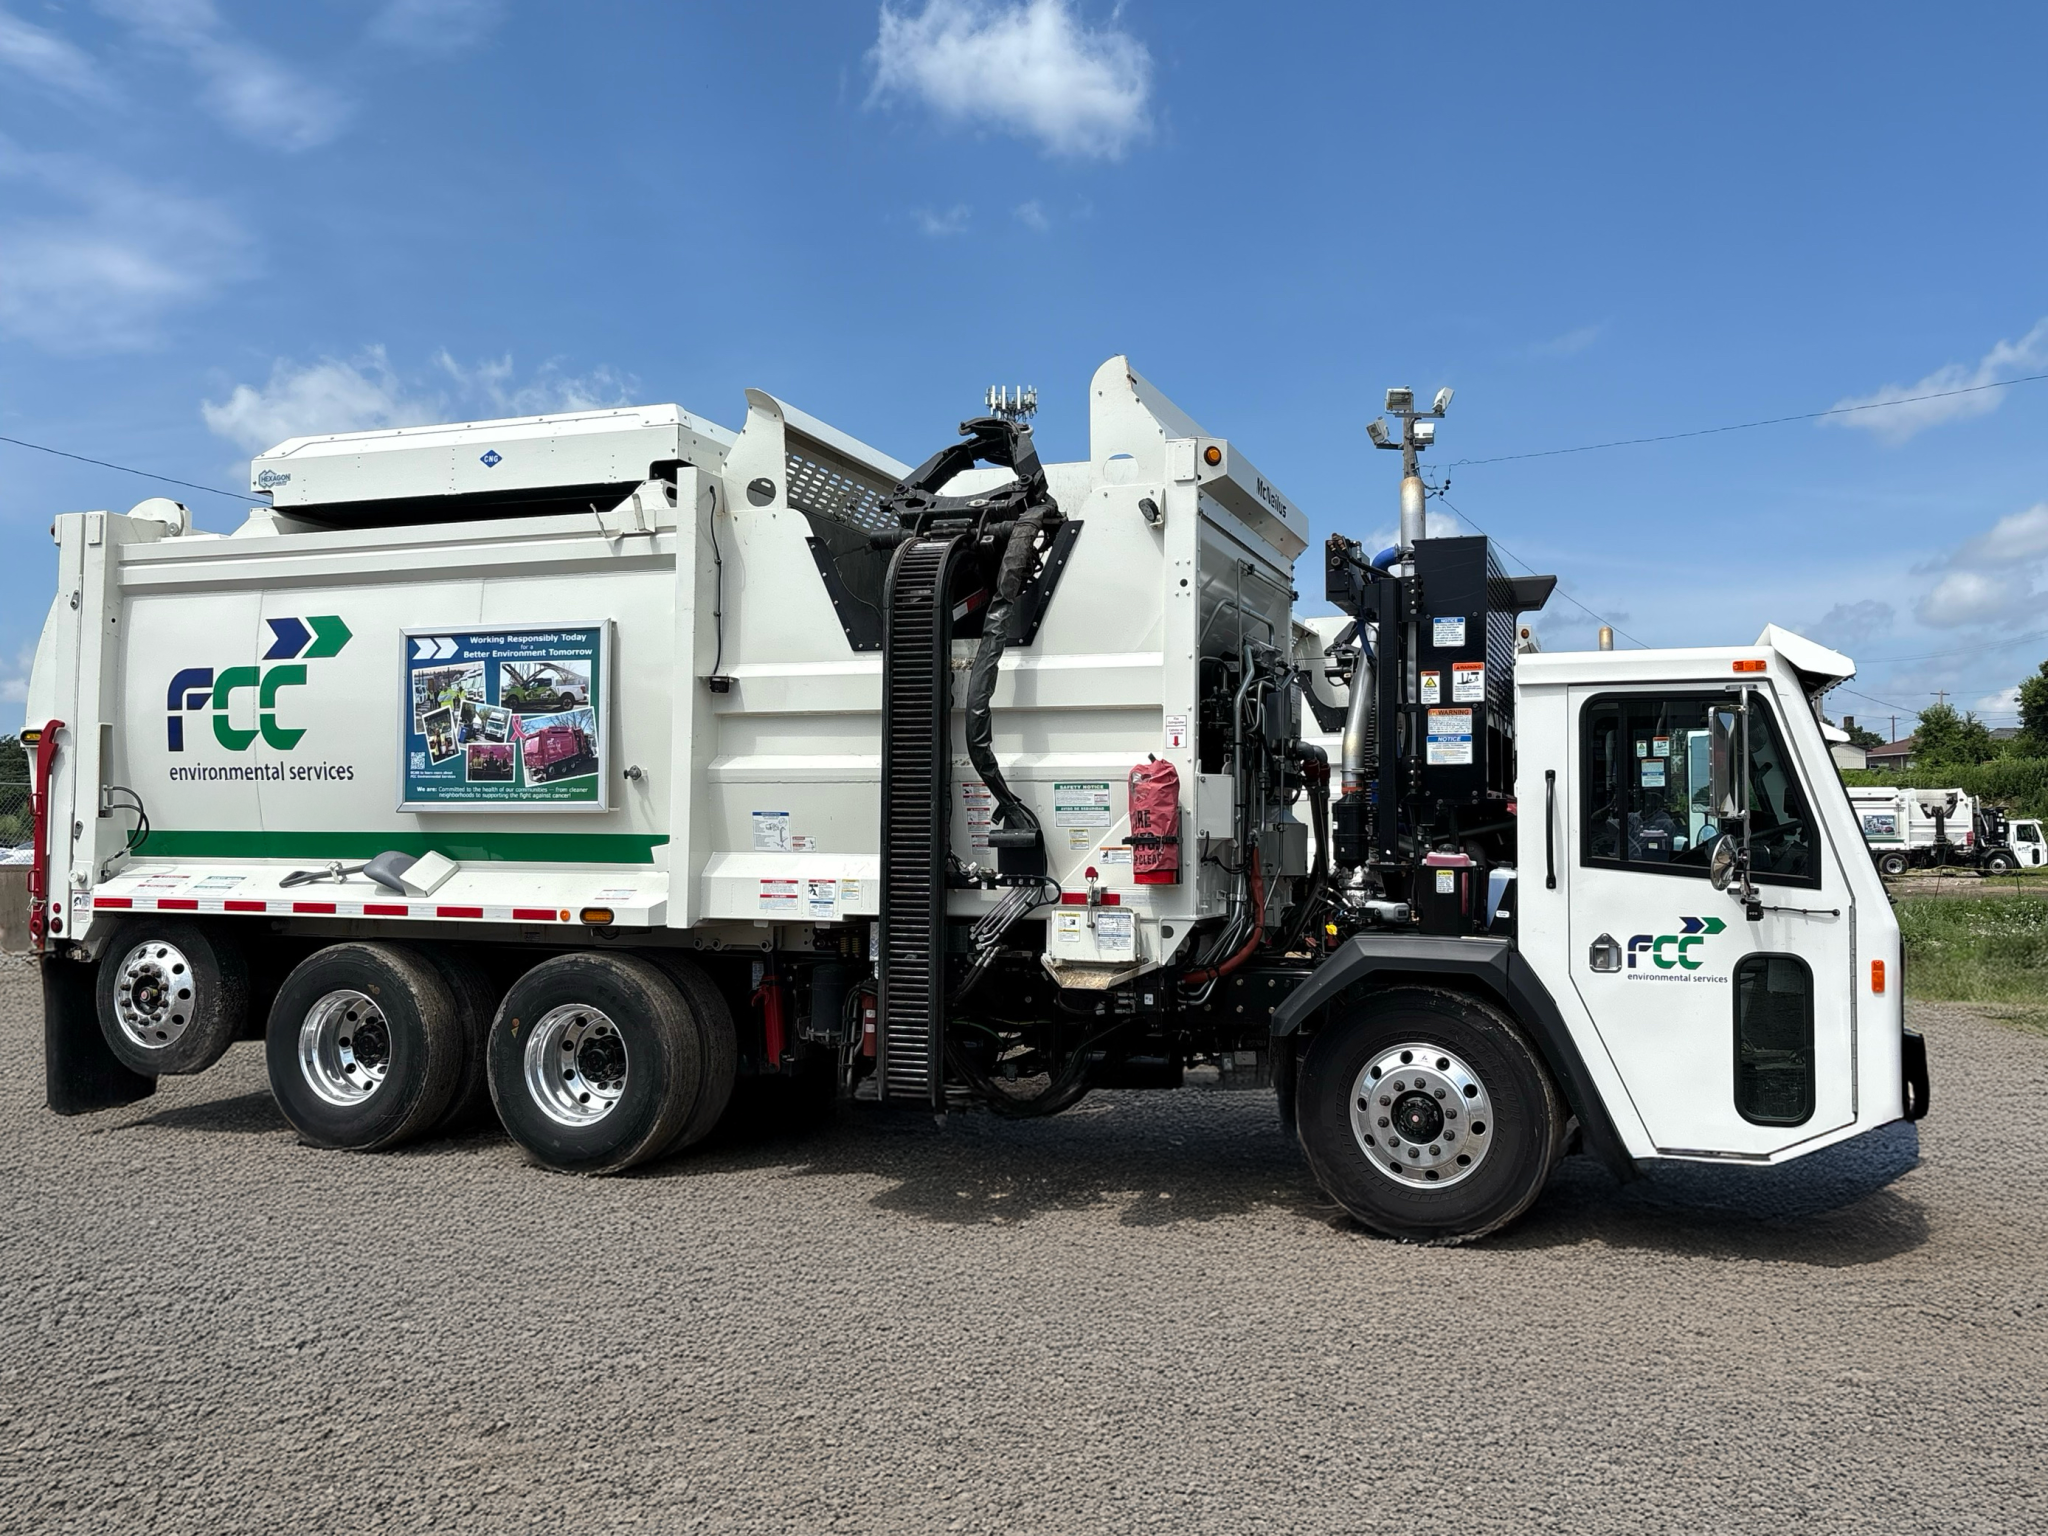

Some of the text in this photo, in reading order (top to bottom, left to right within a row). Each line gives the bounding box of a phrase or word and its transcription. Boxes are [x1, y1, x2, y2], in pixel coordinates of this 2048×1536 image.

[484, 455, 499, 463] CNG
[261, 474, 291, 483] HEXAGON
[1256, 477, 1287, 518] McNeilus
[470, 634, 587, 645] Working Responsibly Today
[464, 648, 593, 659] Better Environment Tomorrow
[167, 664, 307, 752] FCC
[169, 761, 354, 781] environmental services
[1627, 934, 1704, 970] FCC
[1627, 973, 1728, 983] environmental services
